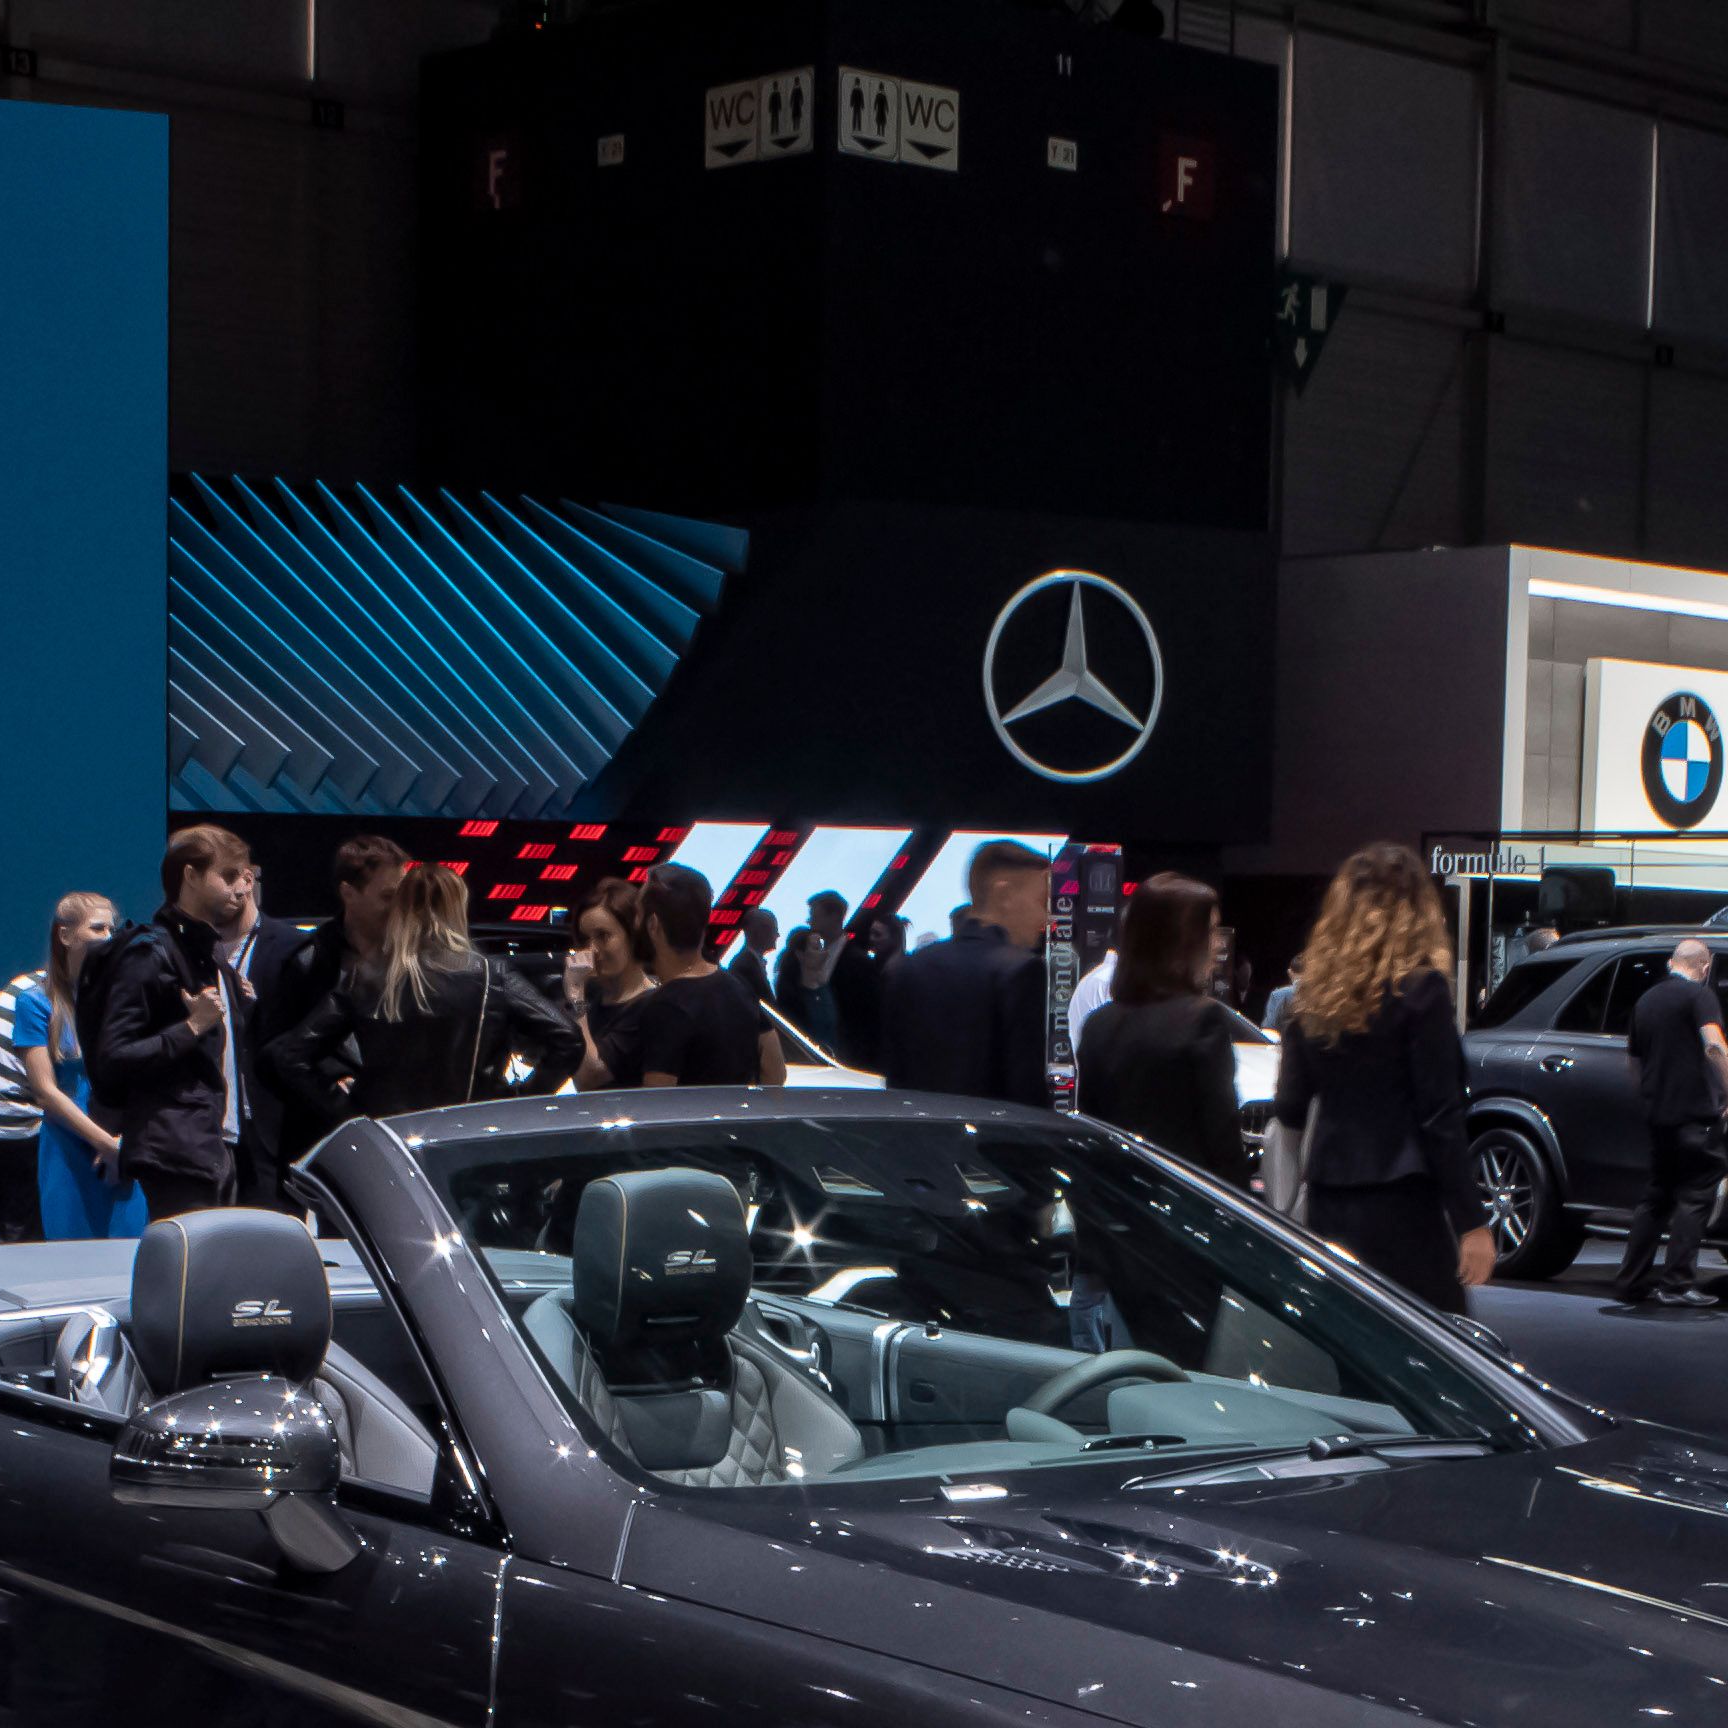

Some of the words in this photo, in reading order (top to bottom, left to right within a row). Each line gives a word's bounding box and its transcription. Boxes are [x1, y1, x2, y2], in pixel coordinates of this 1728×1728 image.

[710, 91, 755, 131] WC
[905, 92, 956, 133] WC
[1177, 155, 1198, 202] F
[1431, 844, 1526, 875] formule
[665, 1249, 716, 1267] SL
[232, 1299, 292, 1318] SL
